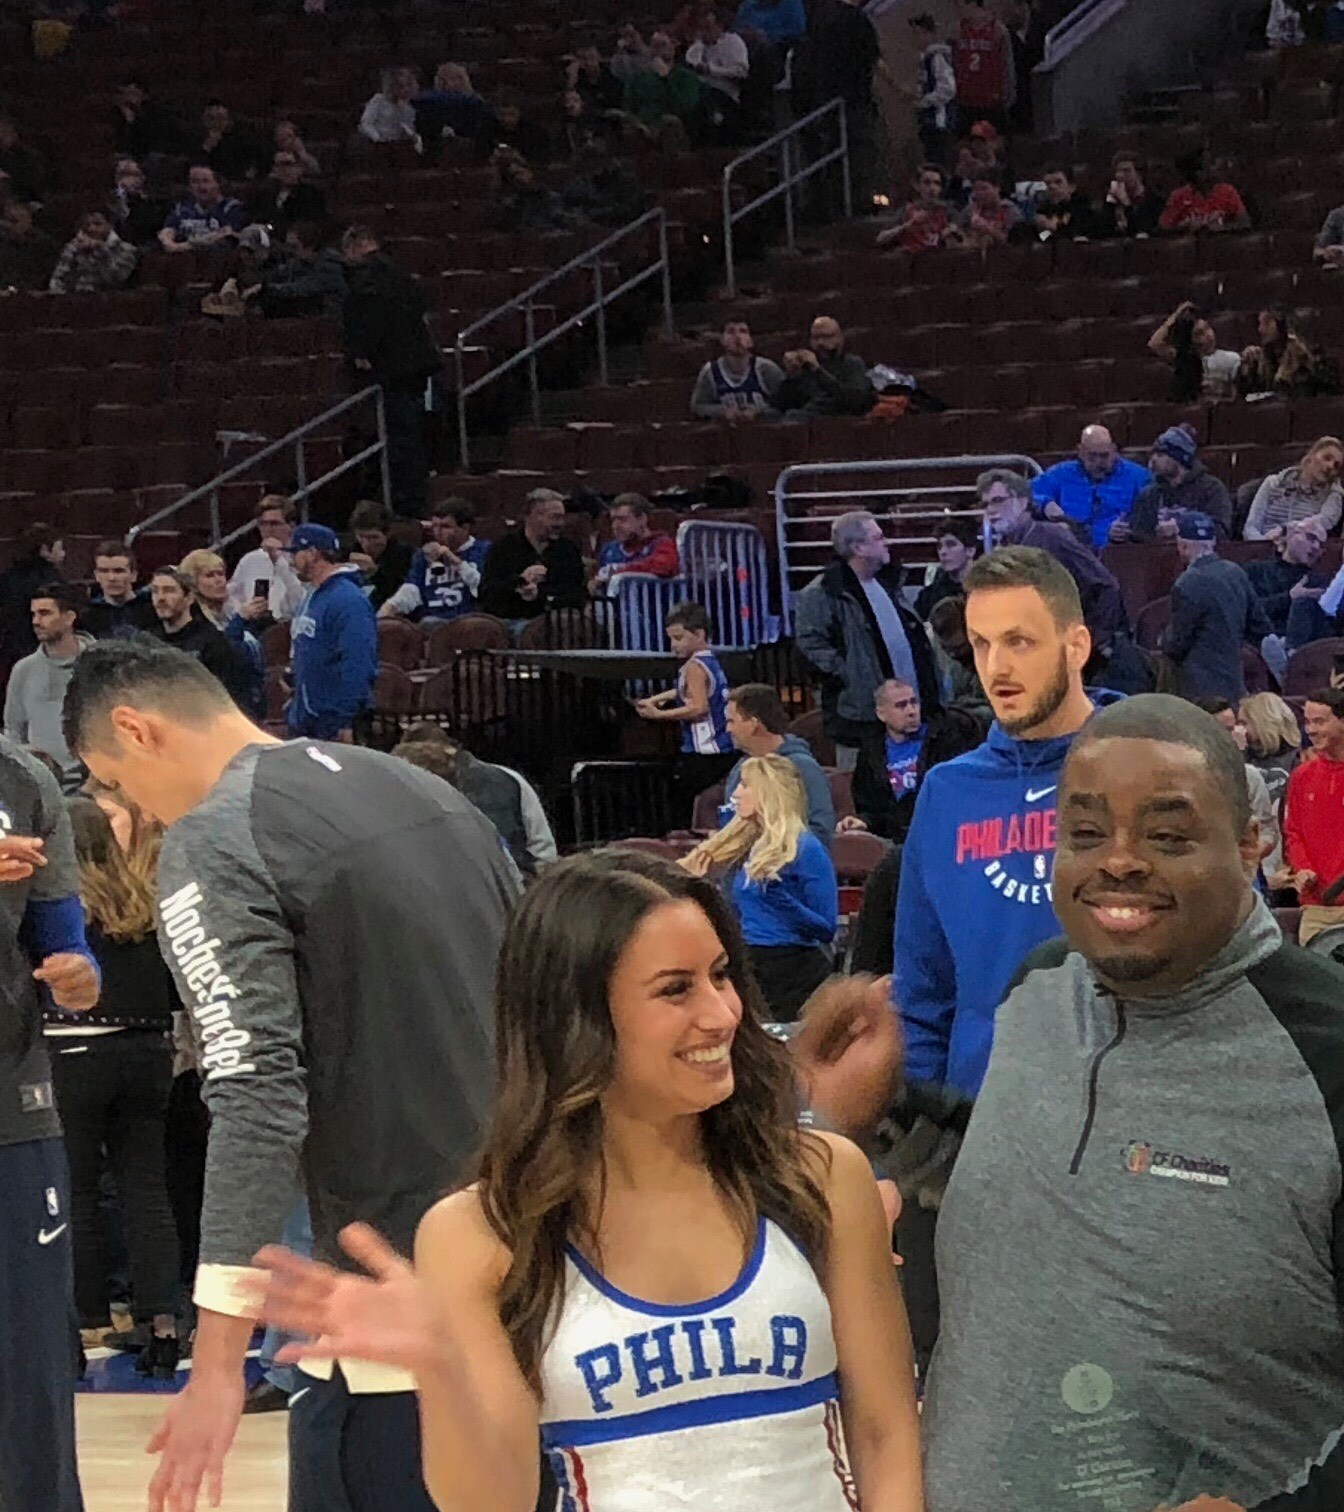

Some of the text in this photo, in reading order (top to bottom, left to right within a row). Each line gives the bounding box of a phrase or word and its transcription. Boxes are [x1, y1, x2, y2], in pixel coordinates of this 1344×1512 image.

[956, 808, 1057, 864] PHILADE
[984, 859, 1053, 904] BASKET
[574, 1315, 808, 1413] PHILA
